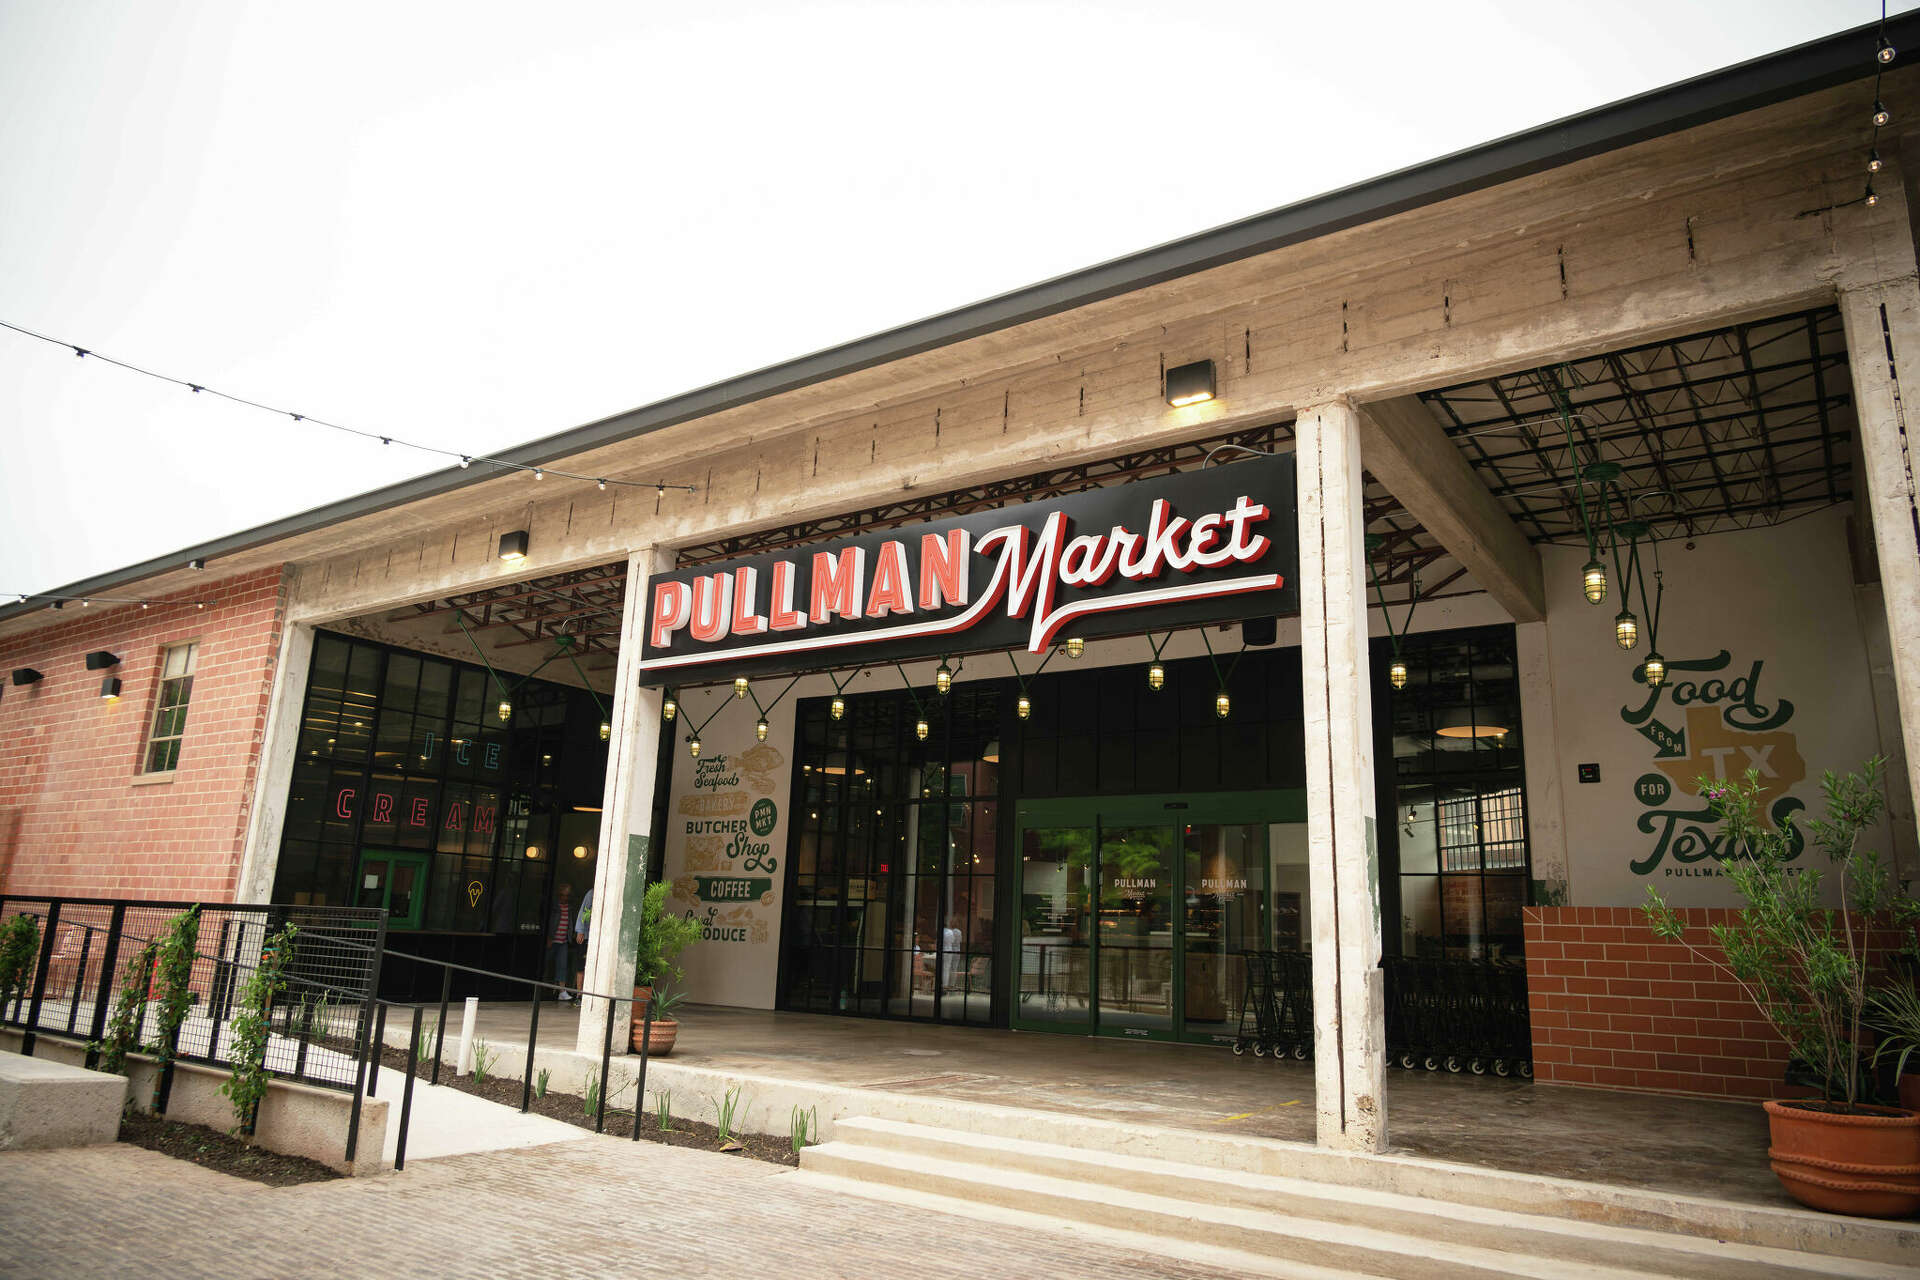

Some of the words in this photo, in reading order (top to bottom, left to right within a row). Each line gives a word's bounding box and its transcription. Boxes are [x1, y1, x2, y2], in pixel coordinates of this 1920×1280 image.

[651, 528, 969, 648] PULLMAN
[972, 495, 1273, 654] Market
[1621, 649, 1794, 731] Food
[424, 732, 501, 769] ICE
[1650, 726, 1682, 753] FROM
[696, 754, 727, 774] Fresh
[1702, 744, 1781, 780] TX
[694, 772, 740, 792] Seafood
[1640, 783, 1665, 796] FOR
[336, 789, 495, 834] CREAM
[686, 820, 748, 834] BUTCHER
[726, 832, 777, 873] Shop
[710, 880, 751, 898] COFFEE
[1114, 878, 1156, 889] PULLMAN
[1201, 878, 1247, 889] PULLMAN
